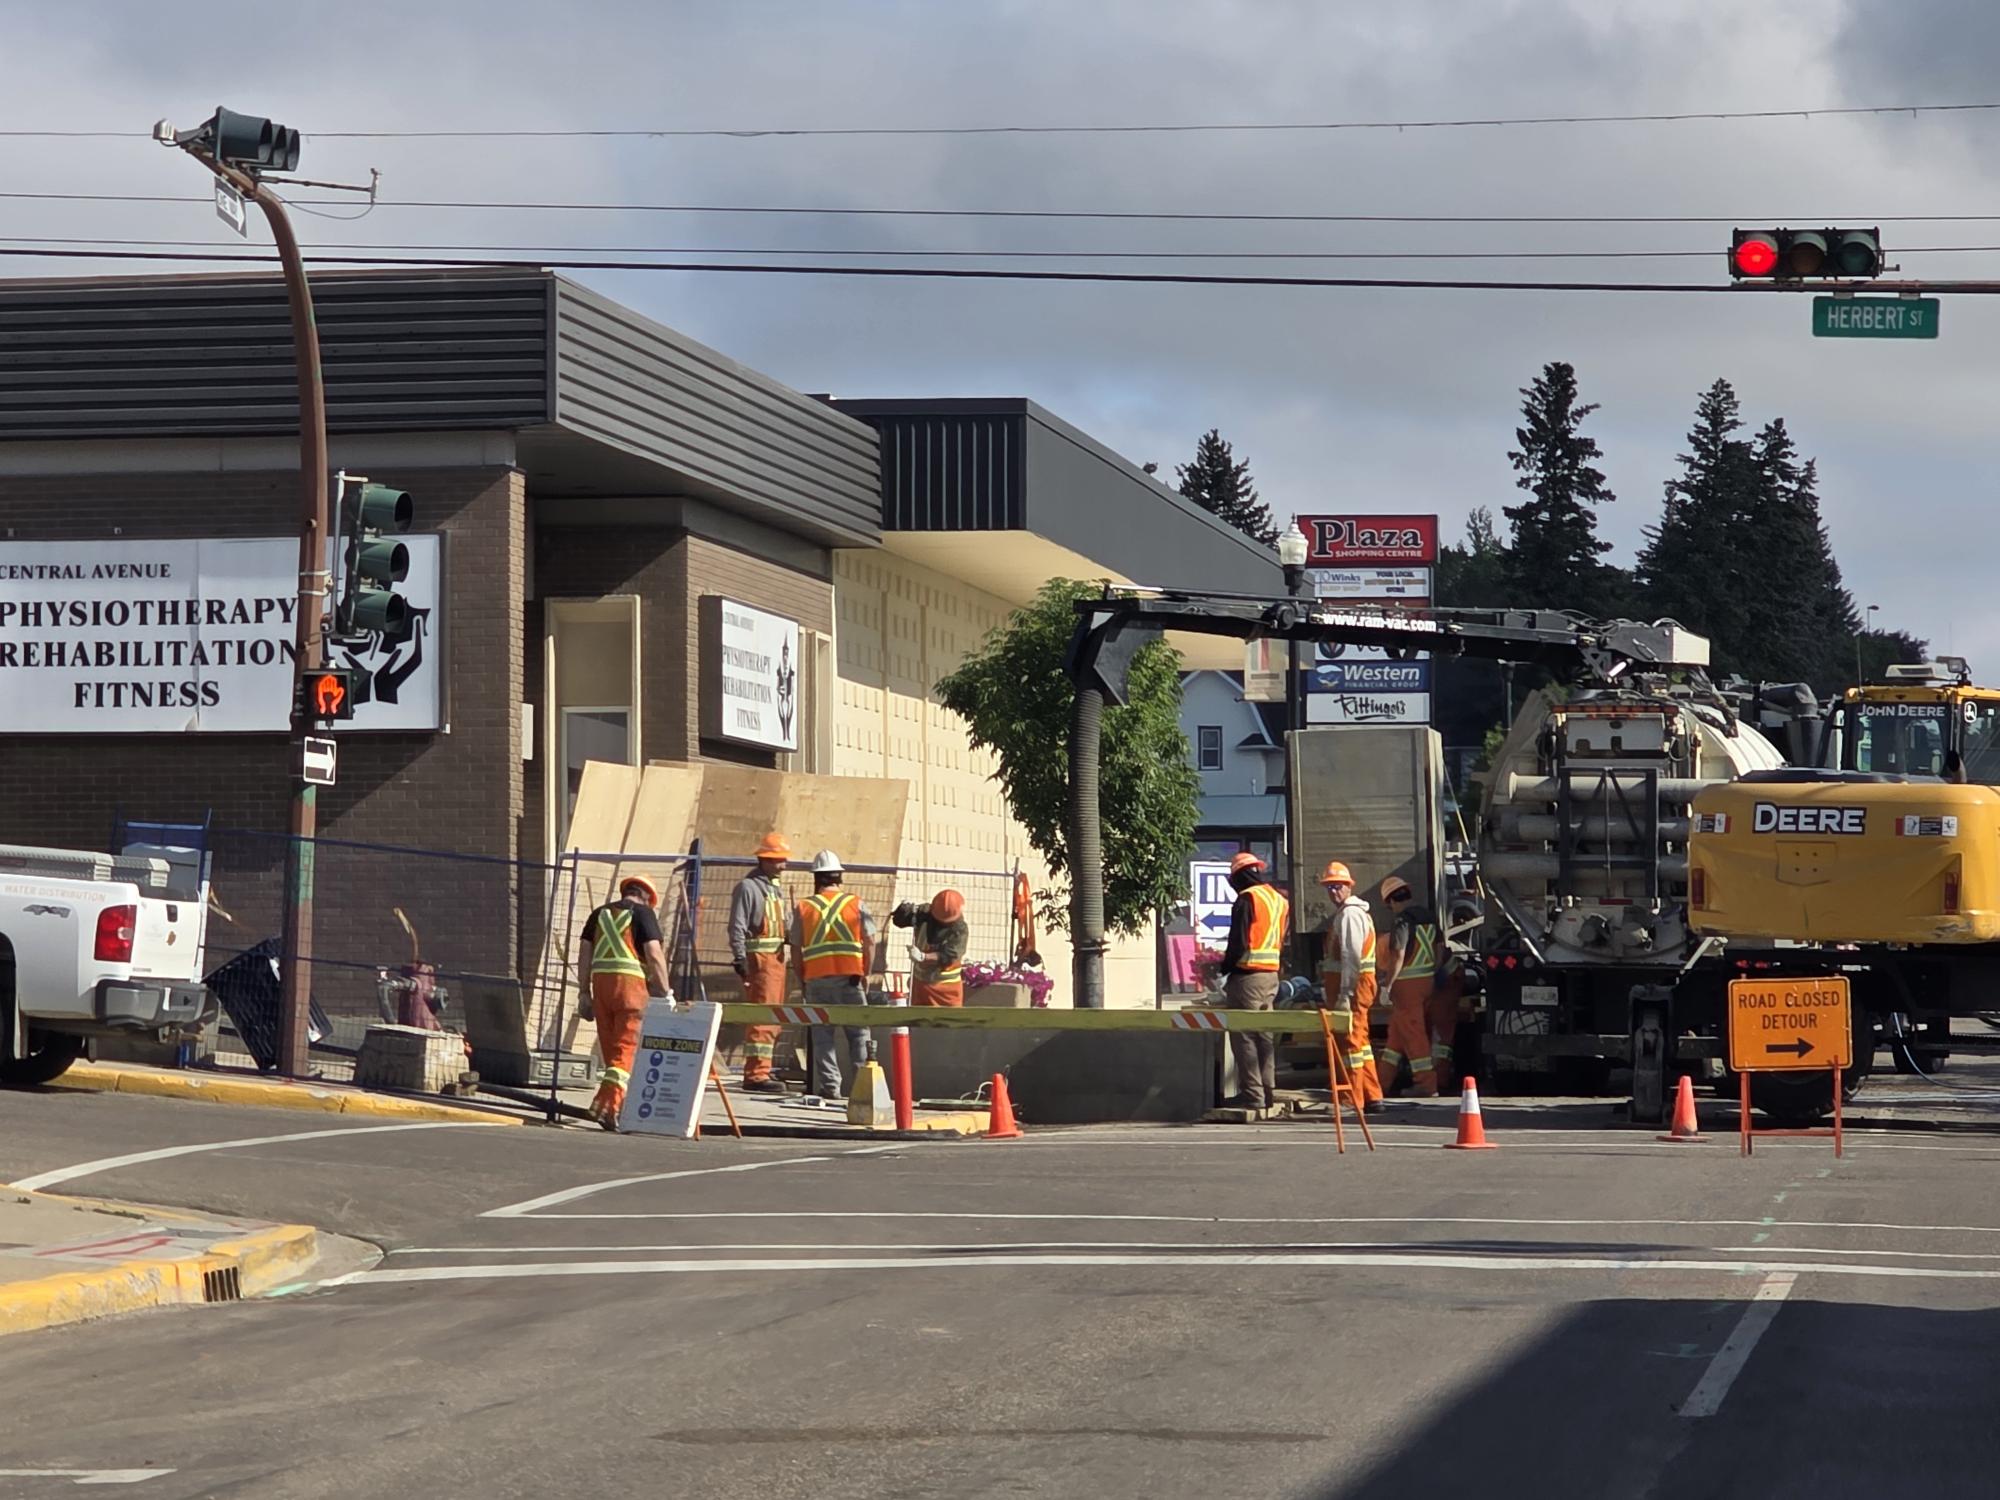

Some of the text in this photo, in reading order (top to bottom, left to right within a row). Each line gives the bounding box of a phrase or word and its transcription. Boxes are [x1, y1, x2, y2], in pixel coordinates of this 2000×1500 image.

[1828, 306, 1924, 329] HERBERT ST
[1311, 520, 1423, 557] Plaza
[0, 564, 171, 580] CENTRAL AVENUE
[0, 597, 297, 627] PHYSIOTHERAPY
[1322, 613, 1437, 632] www.ram-vac.com
[0, 640, 296, 667] REHABILITATION
[1344, 665, 1419, 680] Western
[74, 681, 220, 708] FITNESS
[1858, 704, 1945, 716] JOHN DEERE
[1754, 803, 1865, 833] DEERE
[38, 888, 106, 902] DISTRIBUTION
[1739, 991, 1839, 1008] ROAD CLOSED
[1762, 1013, 1818, 1029] DETOUR
[645, 1036, 700, 1051] WORK ZONE
